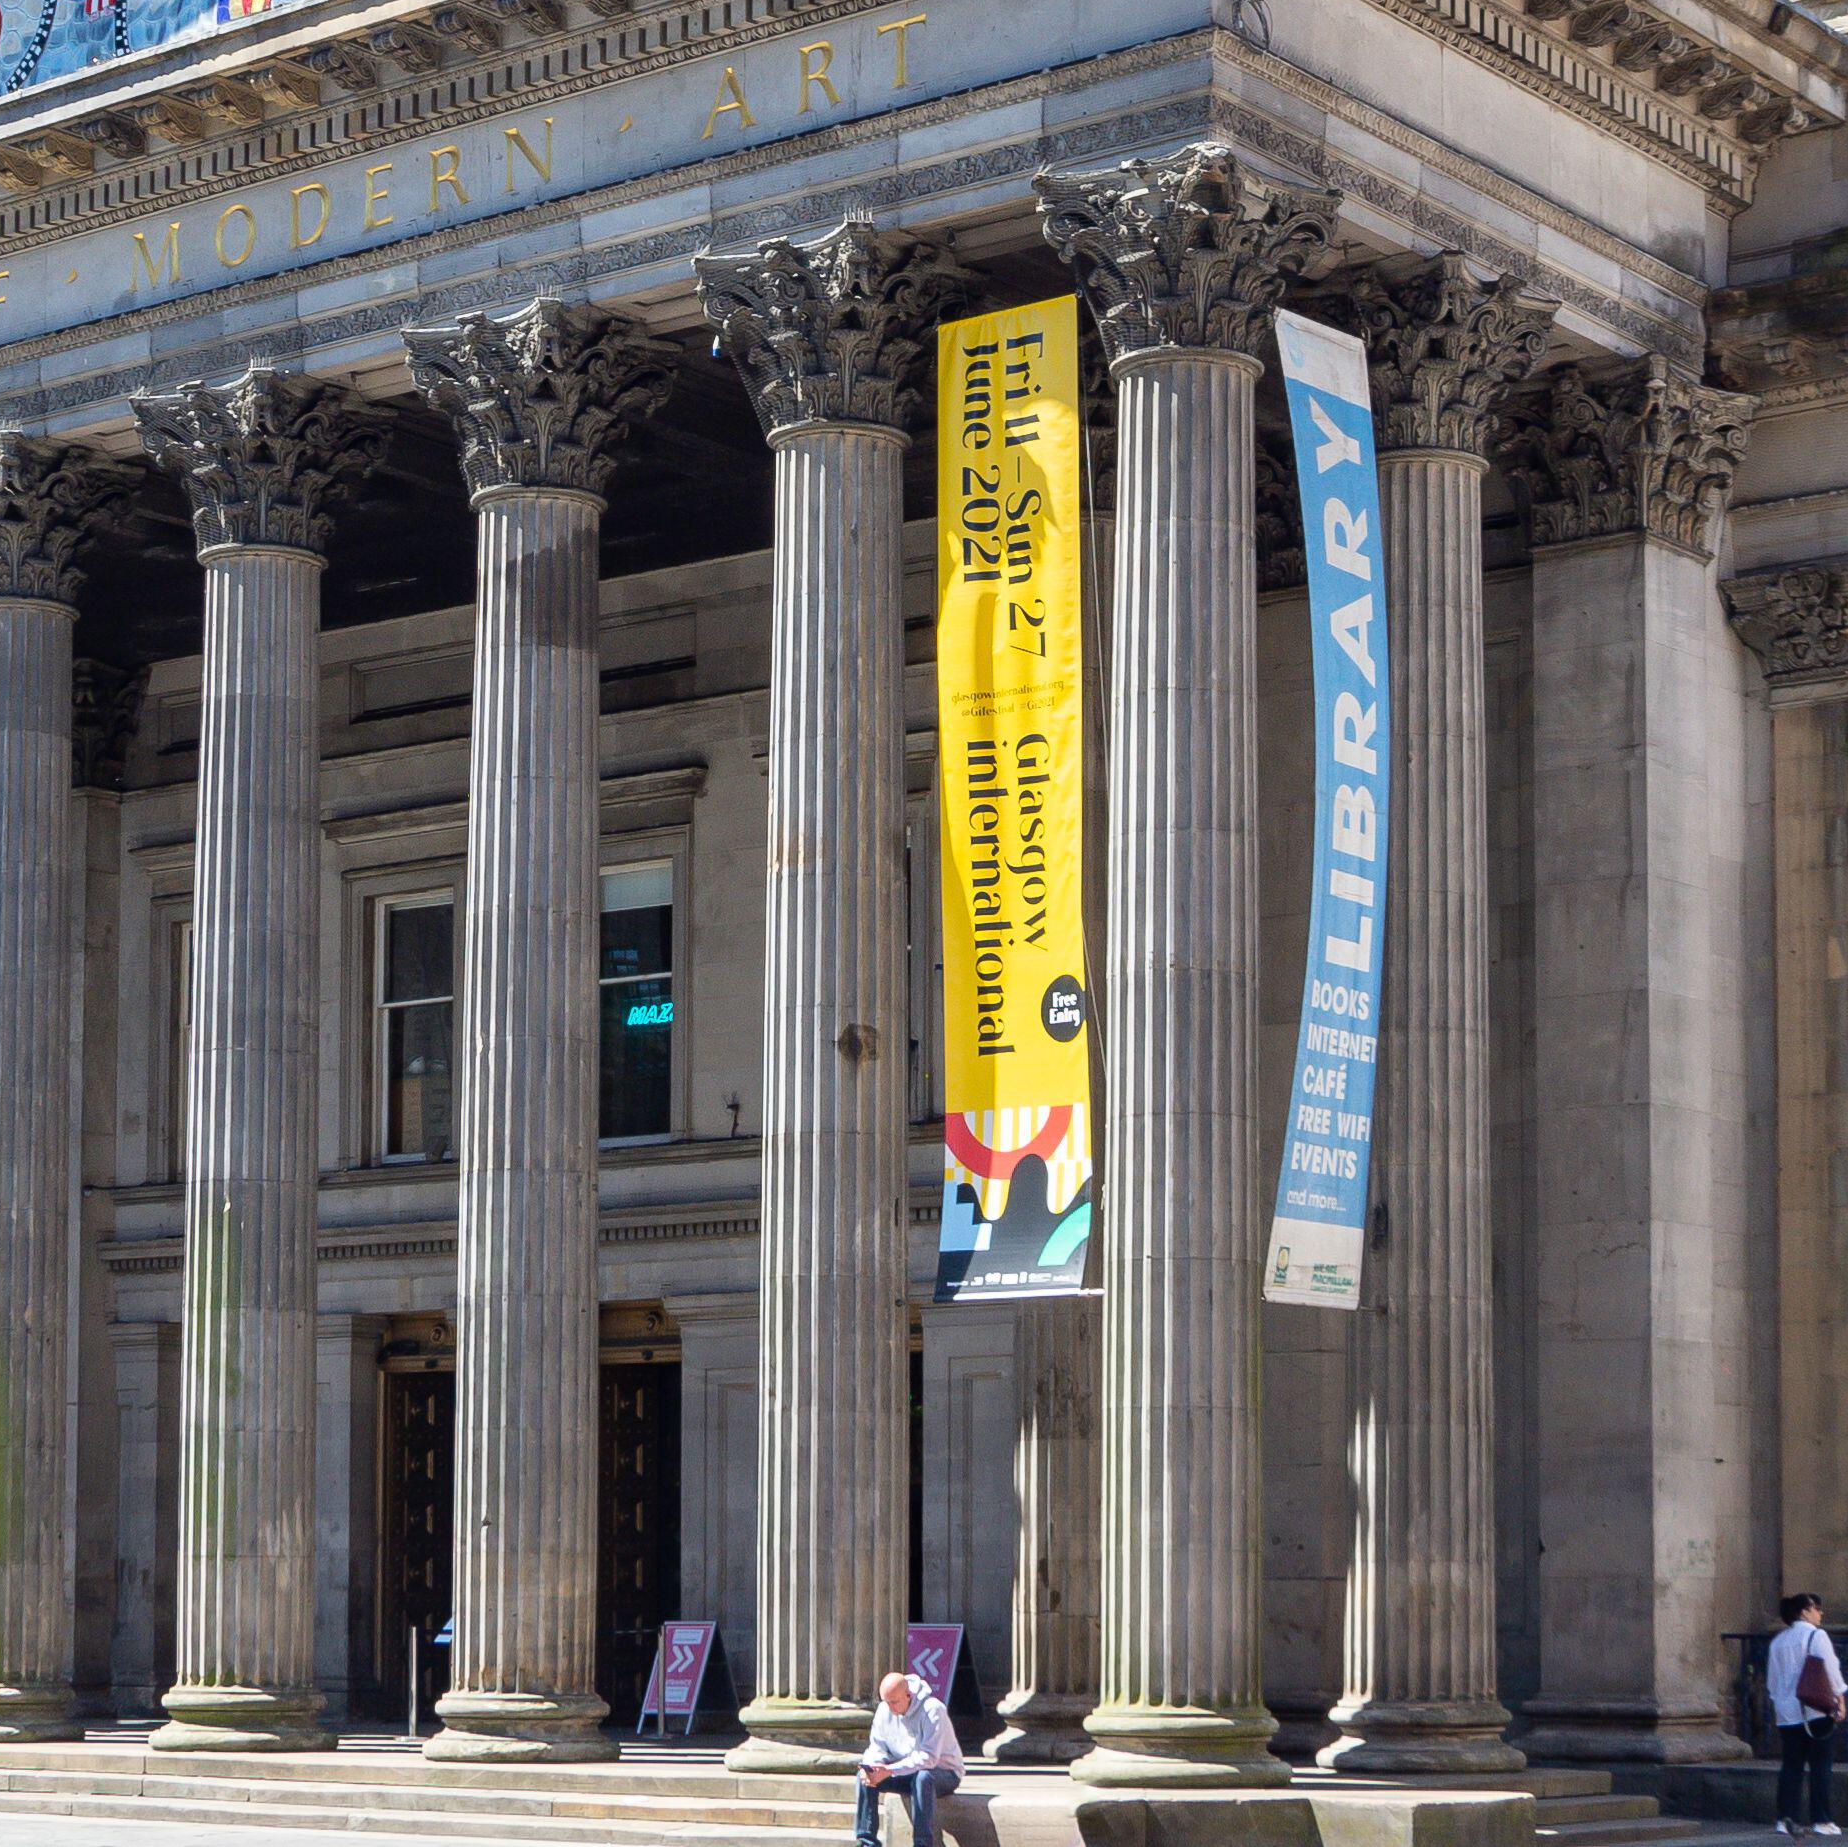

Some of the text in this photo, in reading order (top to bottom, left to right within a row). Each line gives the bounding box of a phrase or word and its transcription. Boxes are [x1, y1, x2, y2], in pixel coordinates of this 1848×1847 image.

[129, 116, 554, 293] MODERN
[701, 13, 928, 140] ART
[1005, 331, 1044, 400] Fri
[961, 340, 1003, 584] June 2021
[1005, 488, 1043, 585] Sun
[1009, 599, 1047, 658] 27
[1309, 394, 1378, 973] LIBRARY
[1004, 733, 1051, 952] Glasgow
[966, 739, 1016, 1057] international
[627, 1002, 673, 1025] MAZ
[1049, 1007, 1081, 1027] Entry
[1052, 991, 1078, 1008] Free
[1311, 979, 1370, 1021] BOOKS
[1306, 1022, 1377, 1064] INTERNET
[1302, 1063, 1347, 1100] CAFÉ
[1296, 1104, 1371, 1143] FREE WIFI
[1291, 1141, 1357, 1180] EVENTS
[1286, 1189, 1306, 1206] and
